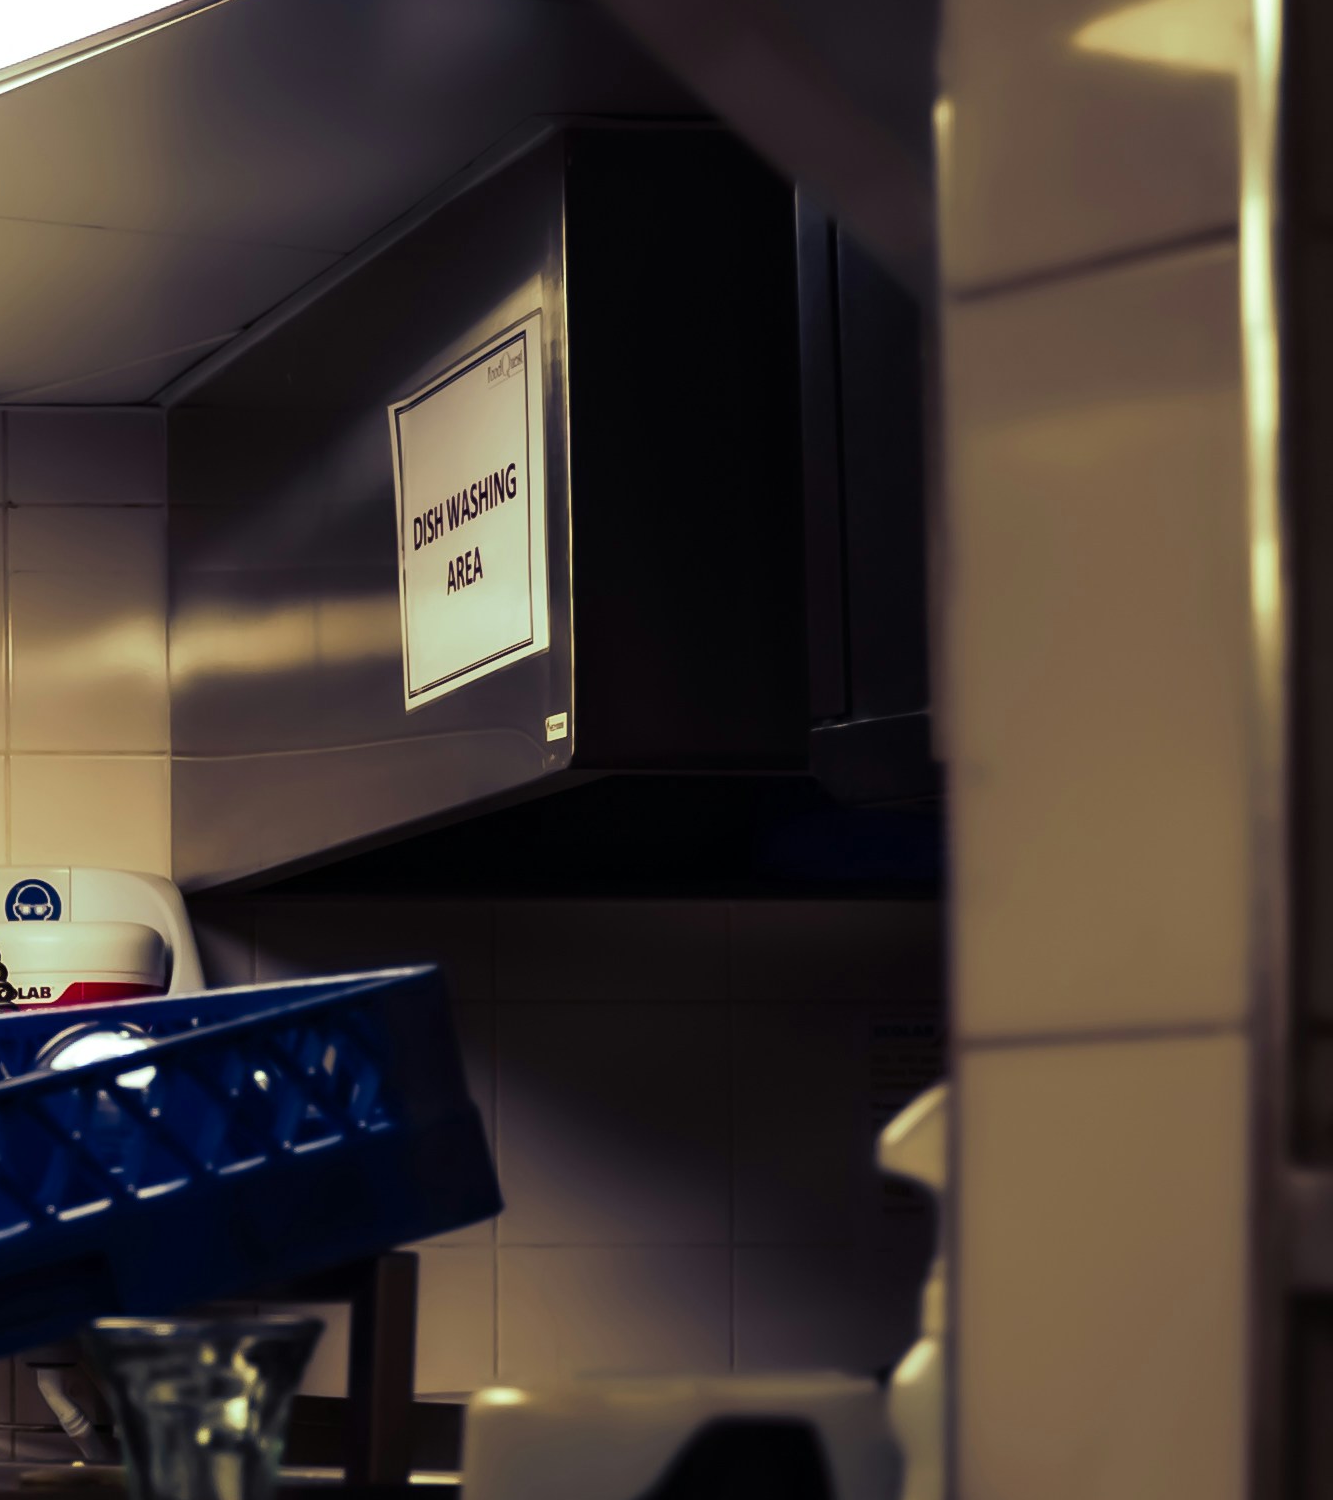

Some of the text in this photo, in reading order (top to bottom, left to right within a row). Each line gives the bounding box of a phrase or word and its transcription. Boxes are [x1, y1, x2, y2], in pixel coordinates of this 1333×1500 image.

[413, 462, 517, 551] DISH WASHING
[447, 546, 483, 596] AREA
